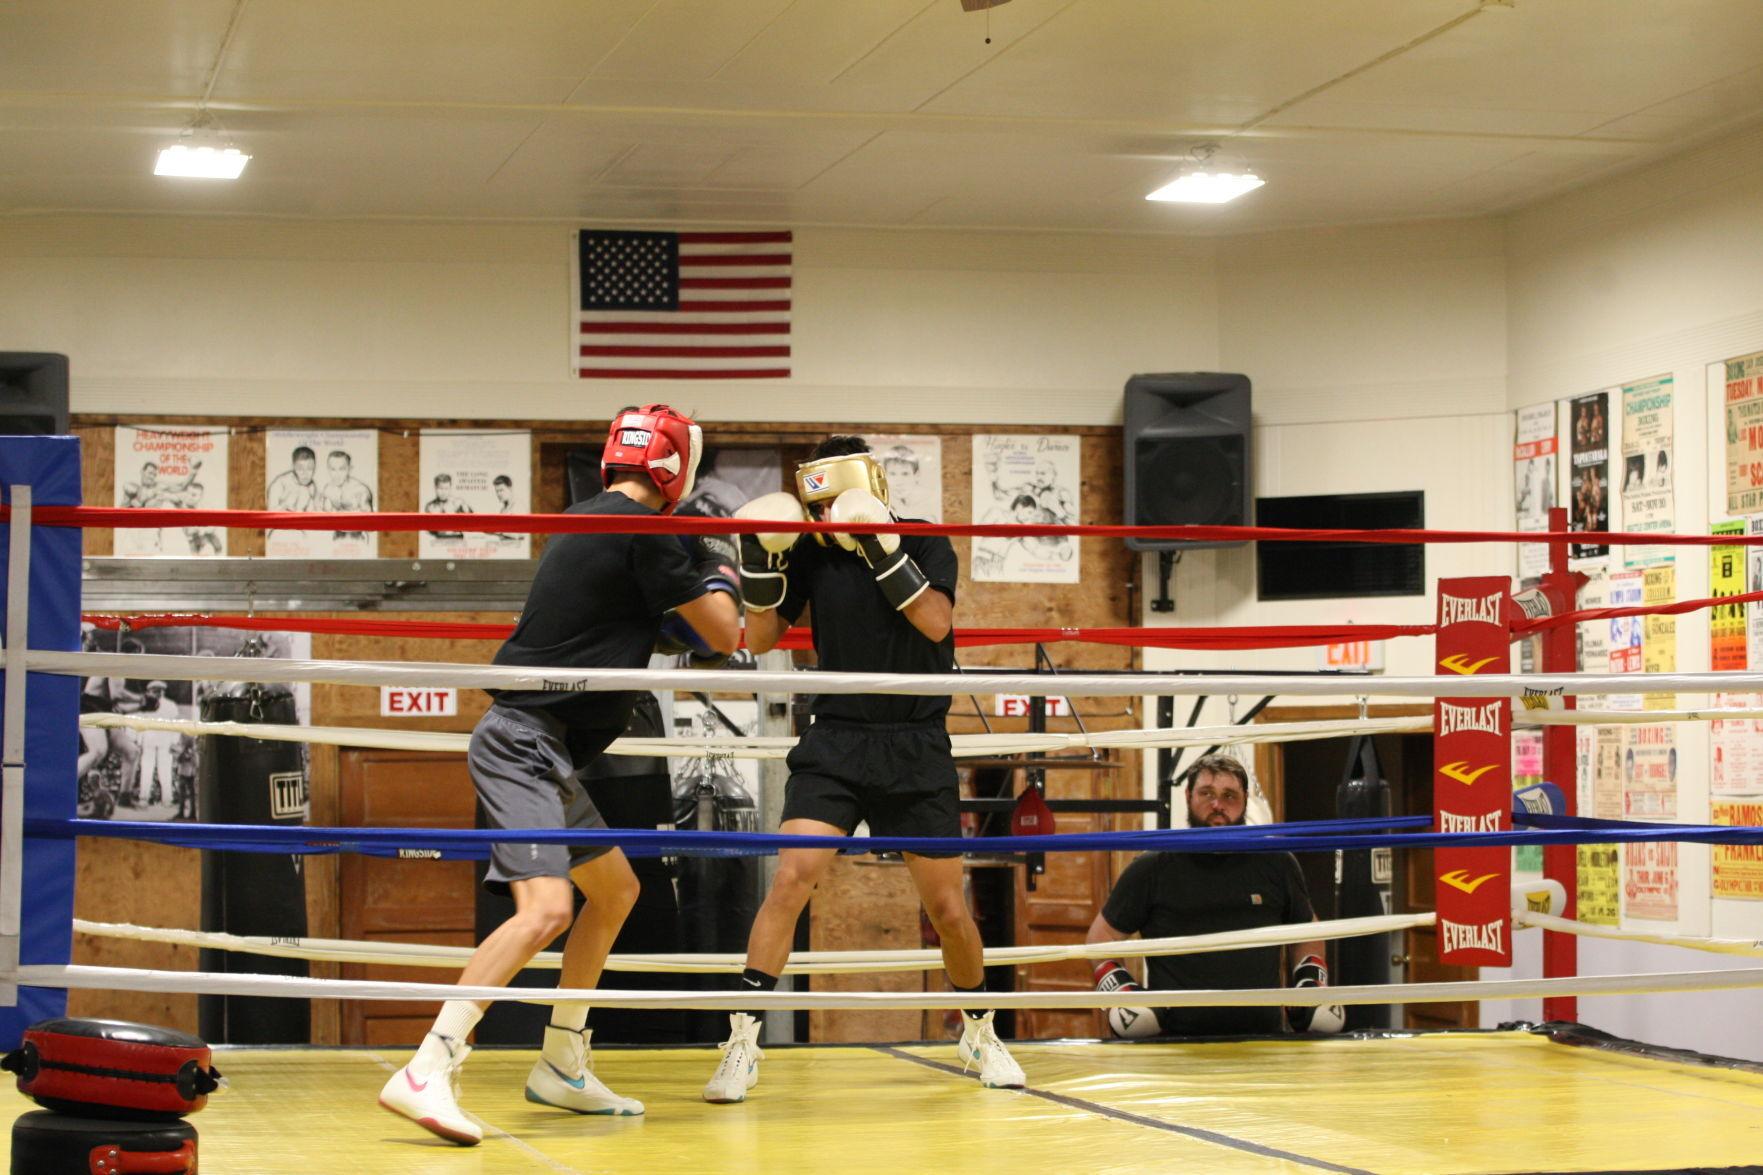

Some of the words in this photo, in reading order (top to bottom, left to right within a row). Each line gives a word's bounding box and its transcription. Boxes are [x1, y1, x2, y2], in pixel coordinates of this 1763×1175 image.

[1626, 394, 1671, 415] CHAMPIONSHIP
[133, 442, 214, 452] CHAMPIONSHIP
[622, 430, 652, 447] RINGSID
[160, 454, 170, 463] OF
[173, 454, 188, 463] THE
[159, 466, 188, 475] WORLD
[1441, 592, 1503, 628] EVERLAST
[389, 692, 448, 712] EXIT
[1004, 699, 1060, 716] EXT
[1440, 701, 1502, 737] EVERLAST
[1638, 728, 1664, 744] BOXING
[1440, 810, 1501, 832] EVERLAST
[1441, 918, 1505, 955] EVERLAST
